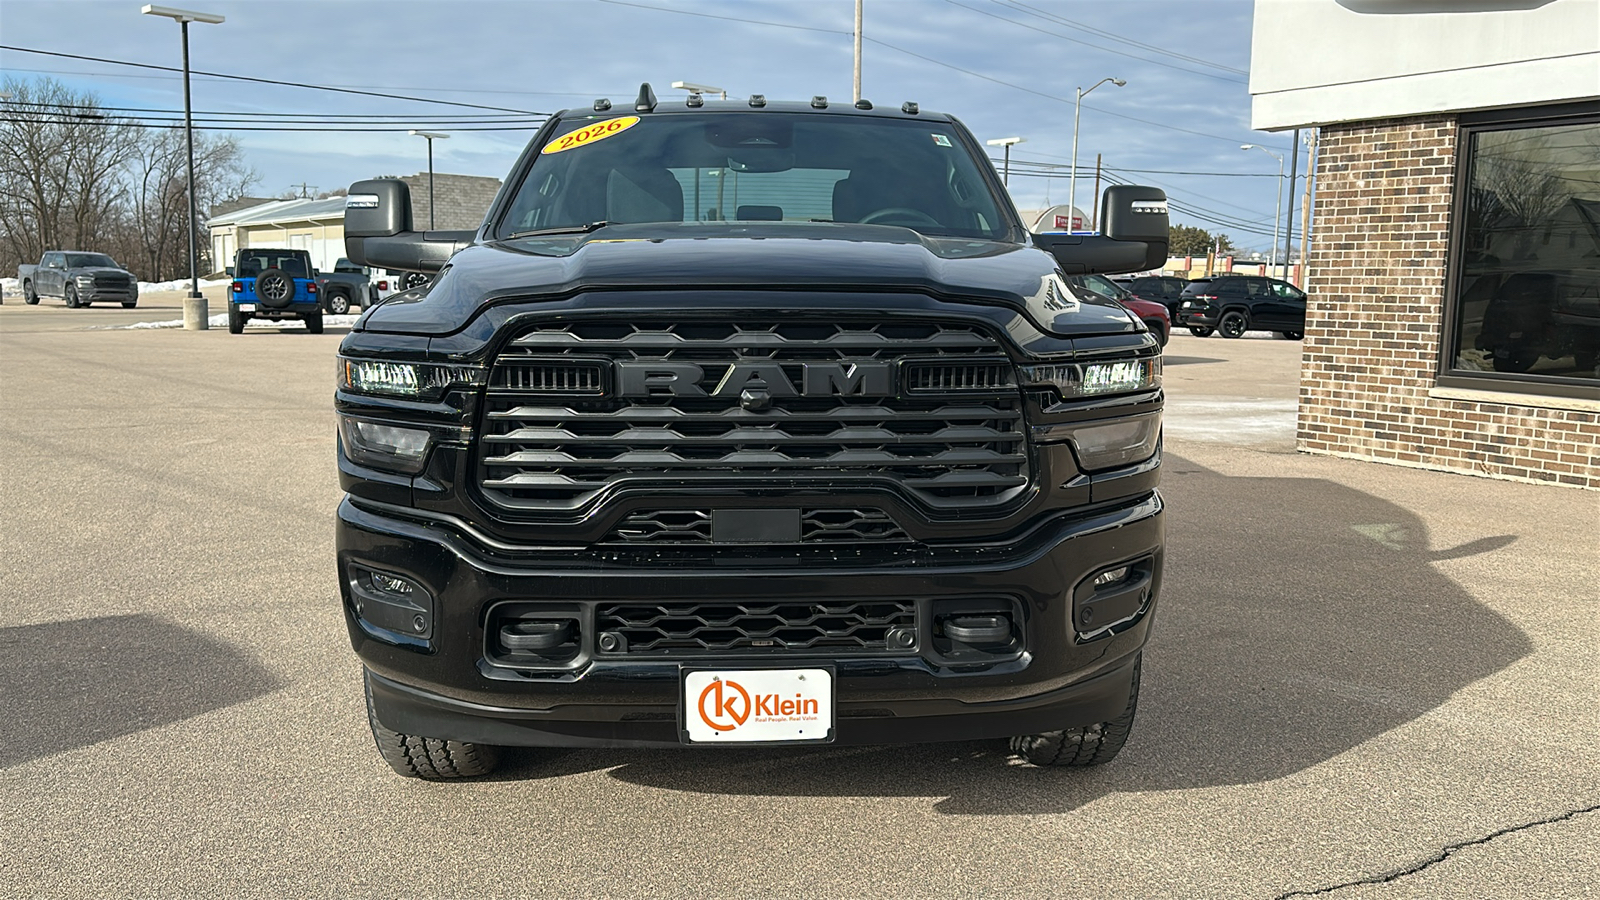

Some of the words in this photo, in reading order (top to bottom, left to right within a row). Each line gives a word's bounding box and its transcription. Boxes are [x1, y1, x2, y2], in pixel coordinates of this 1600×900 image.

[560, 119, 621, 149] 2026
[619, 360, 892, 397] RAM
[755, 693, 818, 716] Klein
